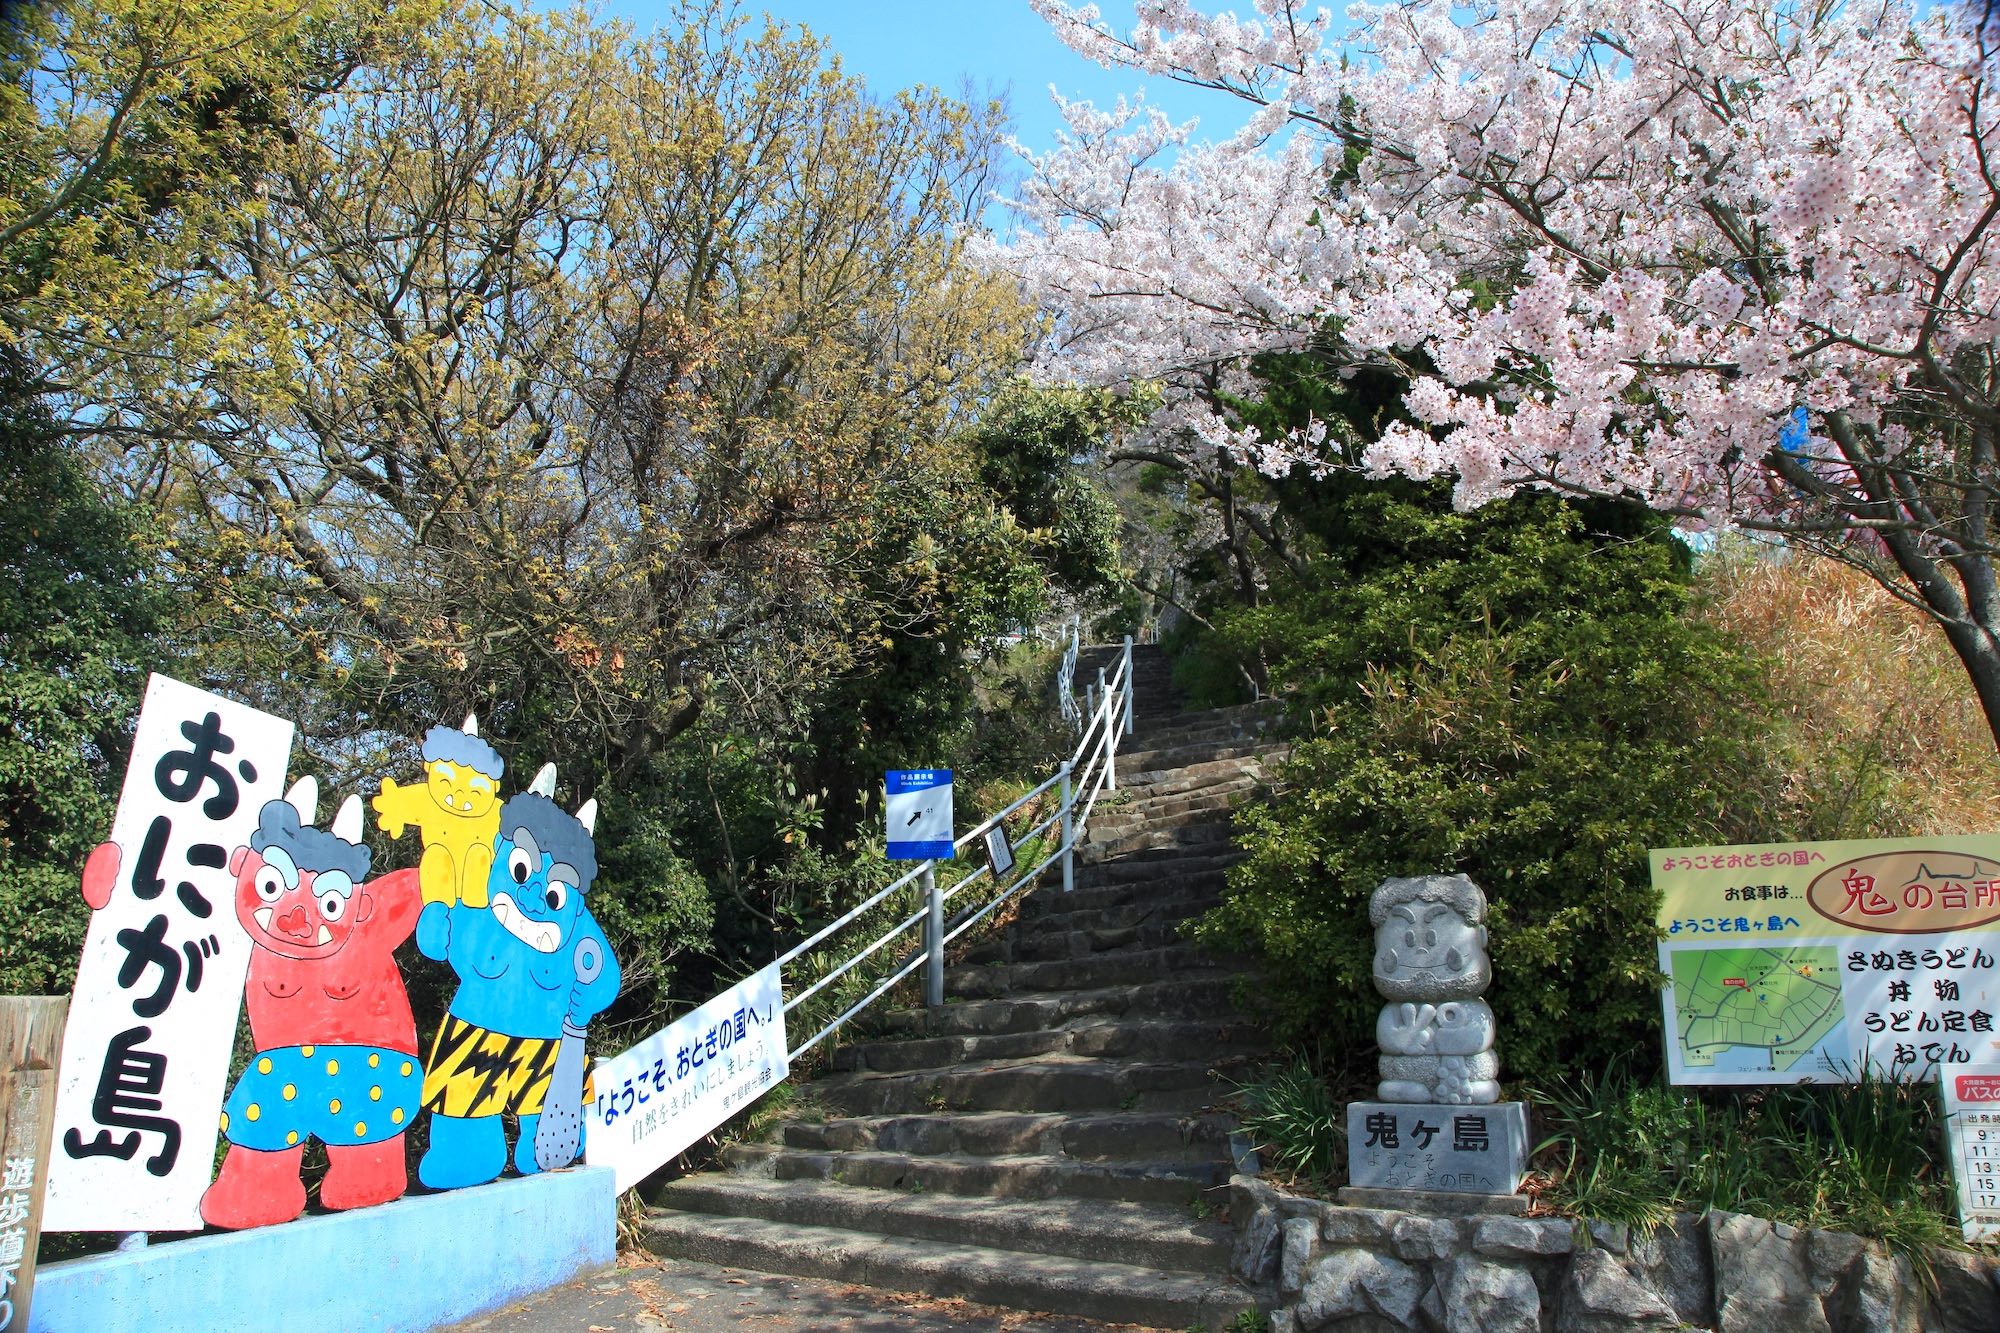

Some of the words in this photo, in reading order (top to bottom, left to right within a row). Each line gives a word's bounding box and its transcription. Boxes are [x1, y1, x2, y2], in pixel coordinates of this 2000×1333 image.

[1662, 850, 1826, 872] ようこそおとぎの国へ
[1838, 868, 2000, 916] 鬼の台所
[1668, 916, 1800, 935] ようこそ鬼ヶ島へ
[63, 711, 257, 1177] おにが島
[1847, 946, 1995, 972] さぬきうどん
[1864, 1009, 1994, 1033] うどん定食
[1894, 1042, 1971, 1064] おでん
[1367, 1153, 1435, 1171] ようこそ
[1385, 1170, 1496, 1190] おとぎの国へ
